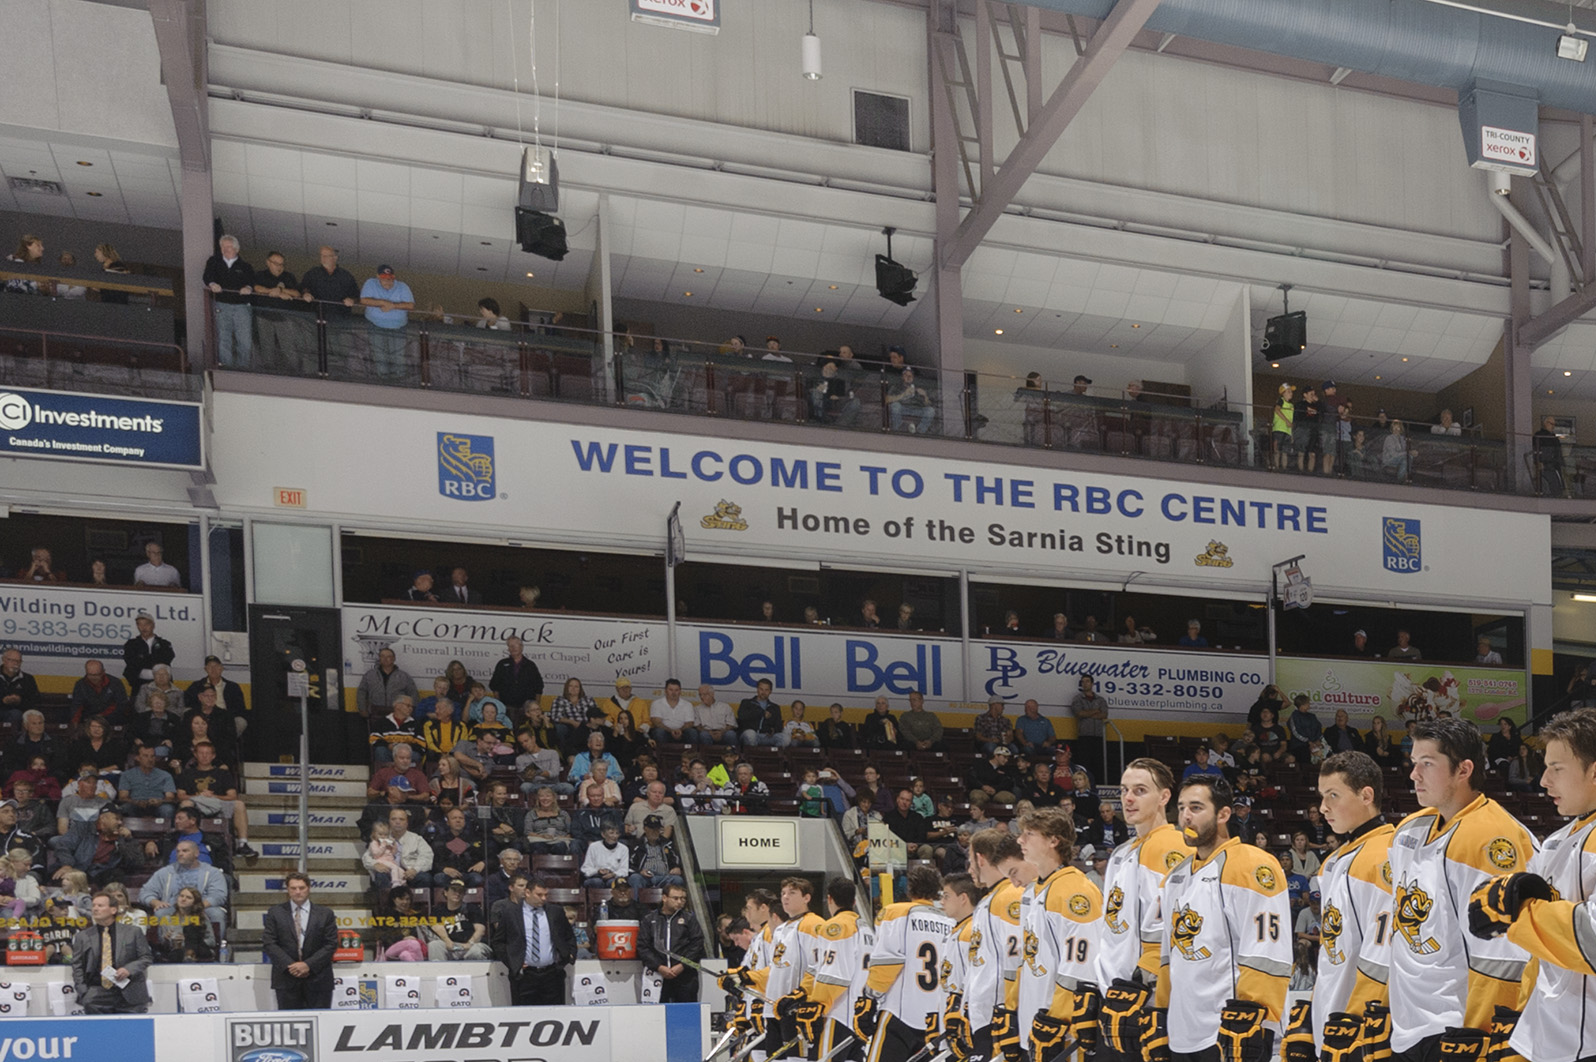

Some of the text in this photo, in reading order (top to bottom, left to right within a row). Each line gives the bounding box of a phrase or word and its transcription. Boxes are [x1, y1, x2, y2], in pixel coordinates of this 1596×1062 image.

[1485, 130, 1531, 144] TRI-COUNTY
[1486, 143, 1516, 155] xerox
[34, 404, 163, 433] Investments
[9, 436, 145, 458] Canada's Investment Company
[444, 480, 491, 499] RBC
[570, 439, 1329, 534] WELCOME TO THE RBC CENTRE
[279, 489, 301, 506] EXIT
[776, 506, 1171, 564] Home of the Sarnia Sting
[1386, 555, 1421, 571] RBC
[155, 604, 197, 622] Ltd.
[356, 614, 554, 644] McCormack
[594, 628, 649, 651] Our First
[403, 643, 450, 657] Funeral
[454, 646, 490, 658] Home
[550, 652, 590, 664] Chapel
[607, 645, 649, 664] Care is
[699, 631, 942, 697] Bell Bell
[615, 660, 651, 678] Yours!
[1036, 649, 1265, 686] Bluewater PLUMBING CO.
[1108, 696, 1223, 711] bluewaterplumbing.ca
[1323, 692, 1380, 705] culture
[738, 837, 781, 848] HOME
[1254, 911, 1280, 942] 15
[1064, 936, 1088, 964] 19
[235, 1023, 311, 1047] BUILT
[333, 1019, 600, 1052] LAMBTON
